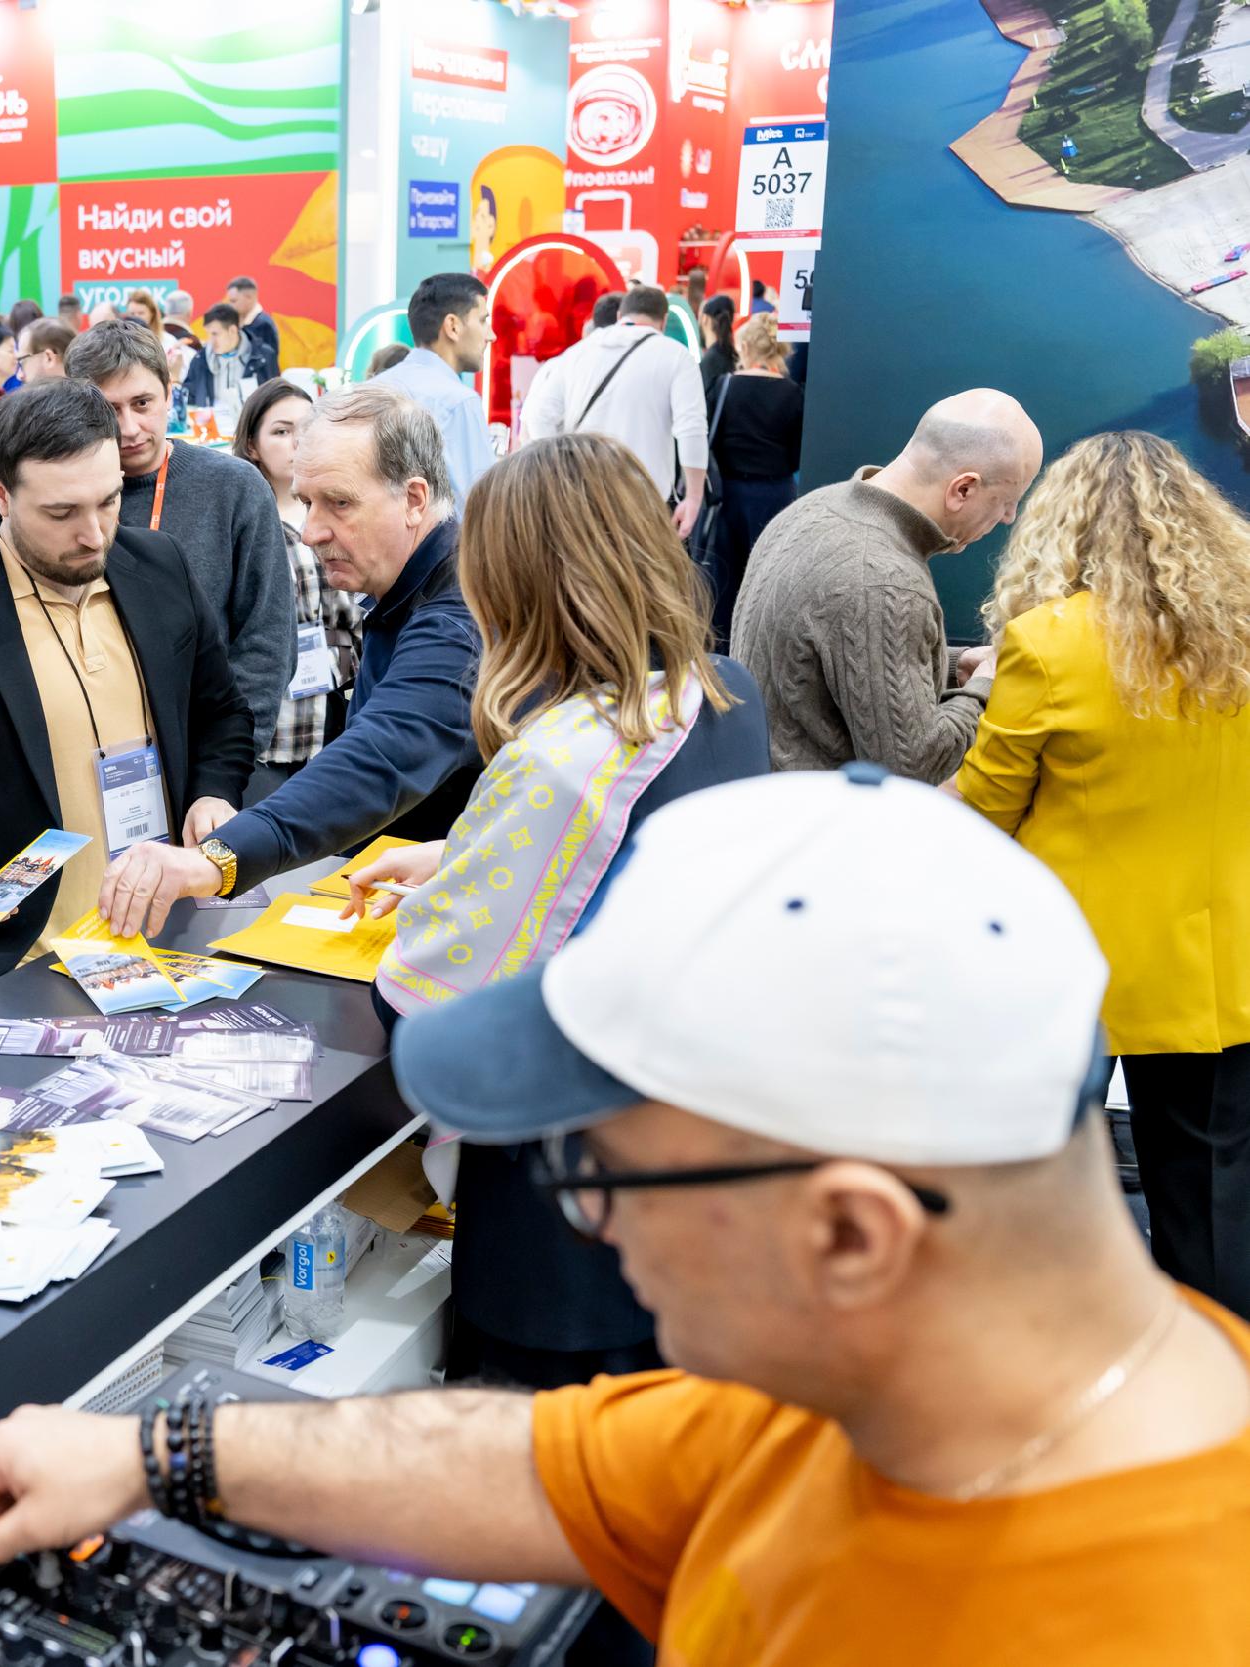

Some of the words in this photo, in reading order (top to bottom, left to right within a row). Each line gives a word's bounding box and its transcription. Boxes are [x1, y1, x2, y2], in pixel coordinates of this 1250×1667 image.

[752, 172, 813, 195] 5037
[77, 202, 163, 234] Найди
[168, 198, 232, 229] свой
[78, 239, 185, 275] вкусный
[77, 286, 168, 314] уголк
[296, 1243, 310, 1287] Vorgol
